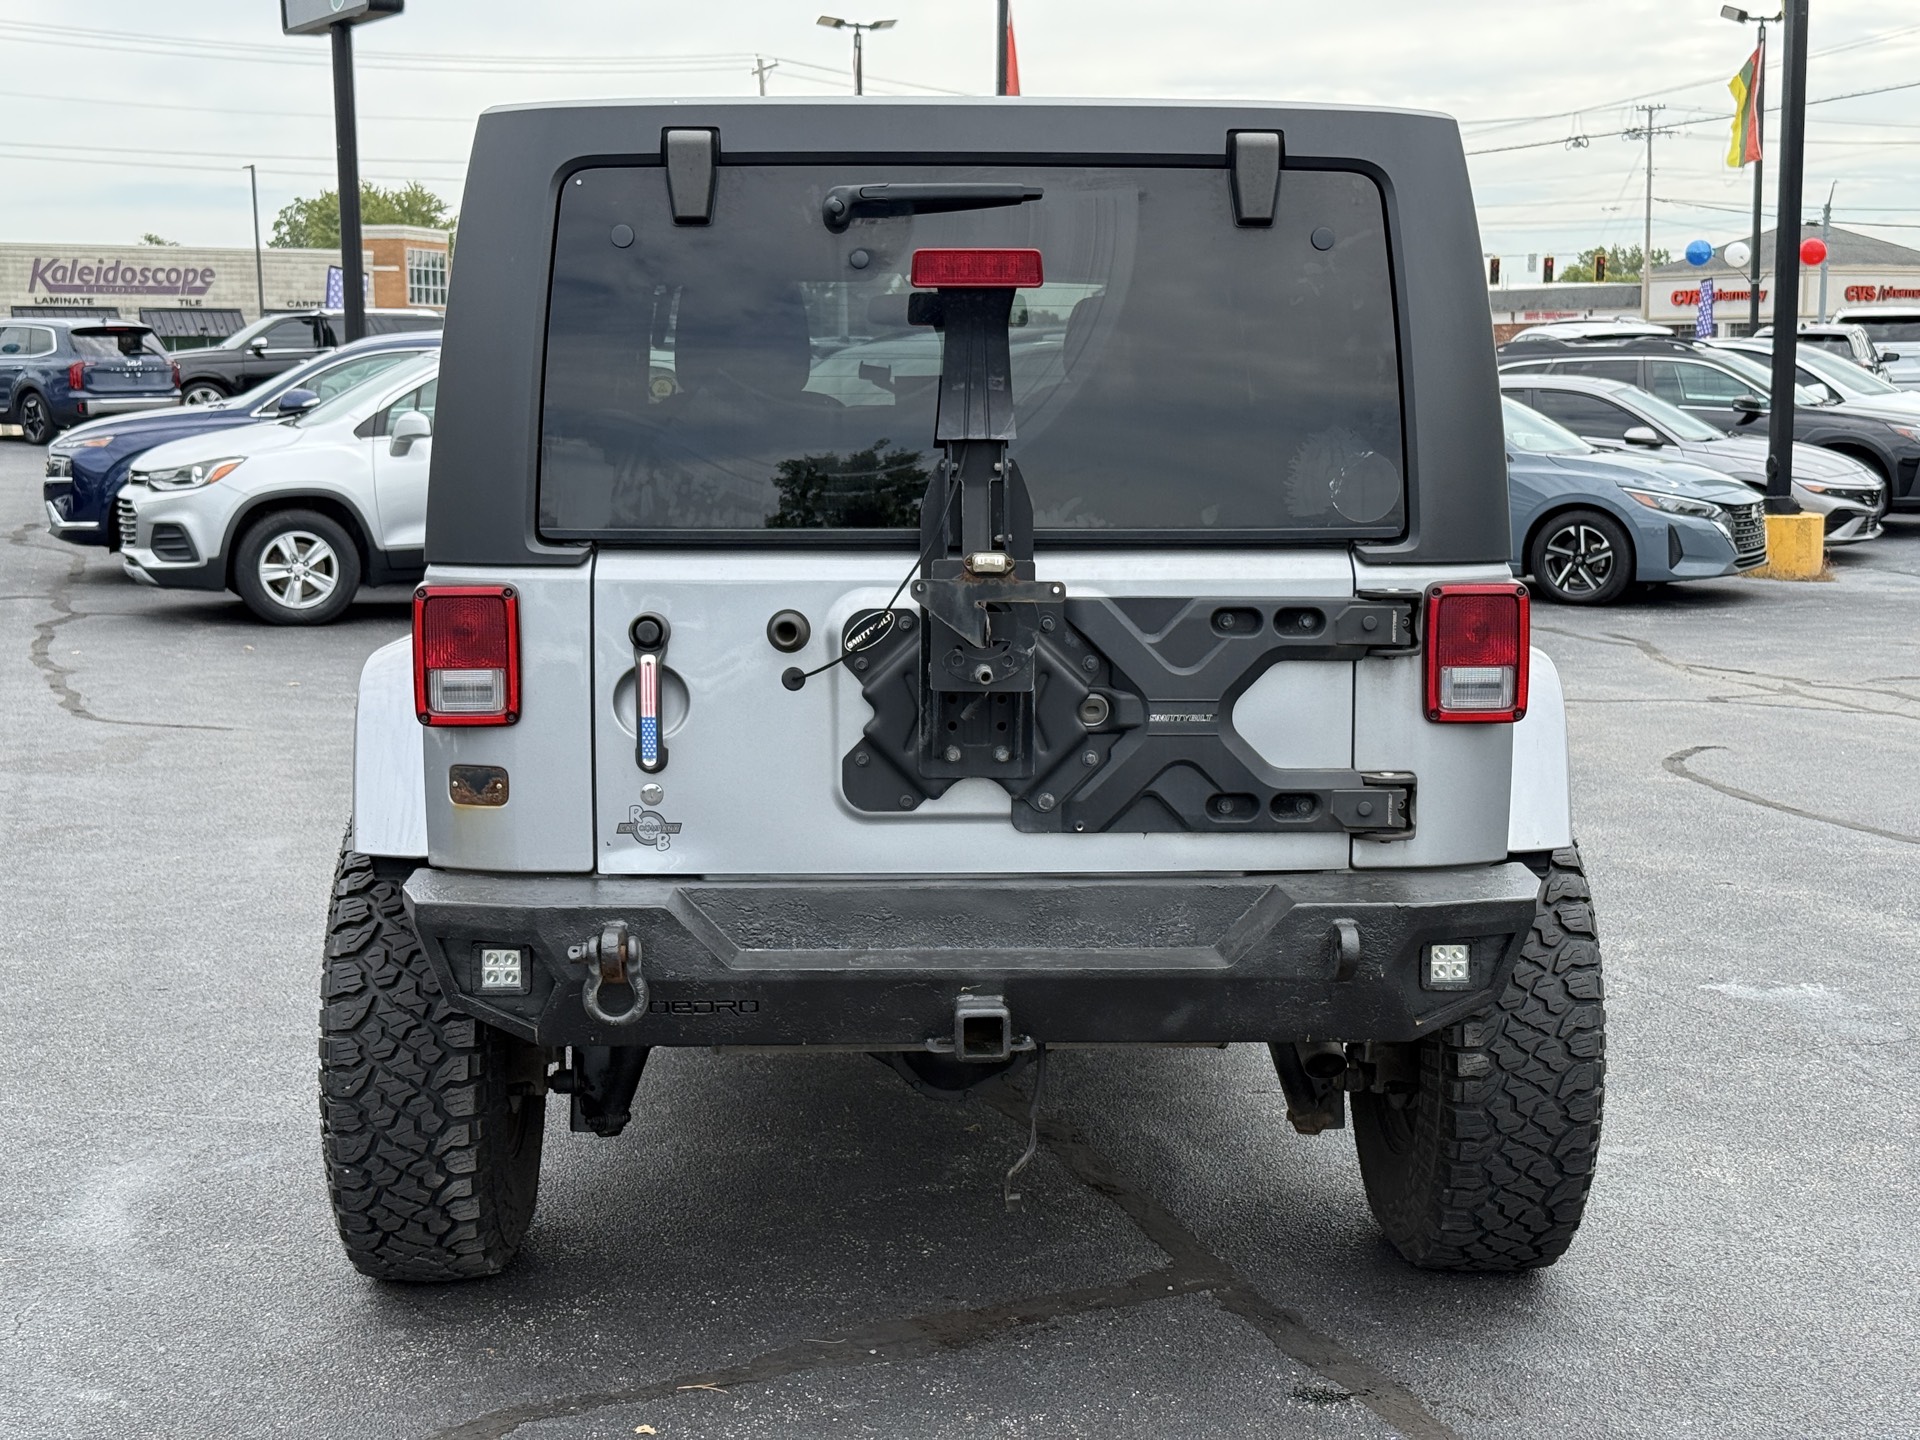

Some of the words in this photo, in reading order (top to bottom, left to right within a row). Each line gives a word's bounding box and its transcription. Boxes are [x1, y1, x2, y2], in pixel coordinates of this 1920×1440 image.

[28, 258, 216, 296] Kaleidoscope
[34, 297, 95, 306] LAMINATE
[178, 299, 203, 307] TILE
[846, 613, 892, 649] SMITTYILT
[1148, 714, 1214, 722] SMITTYBILT
